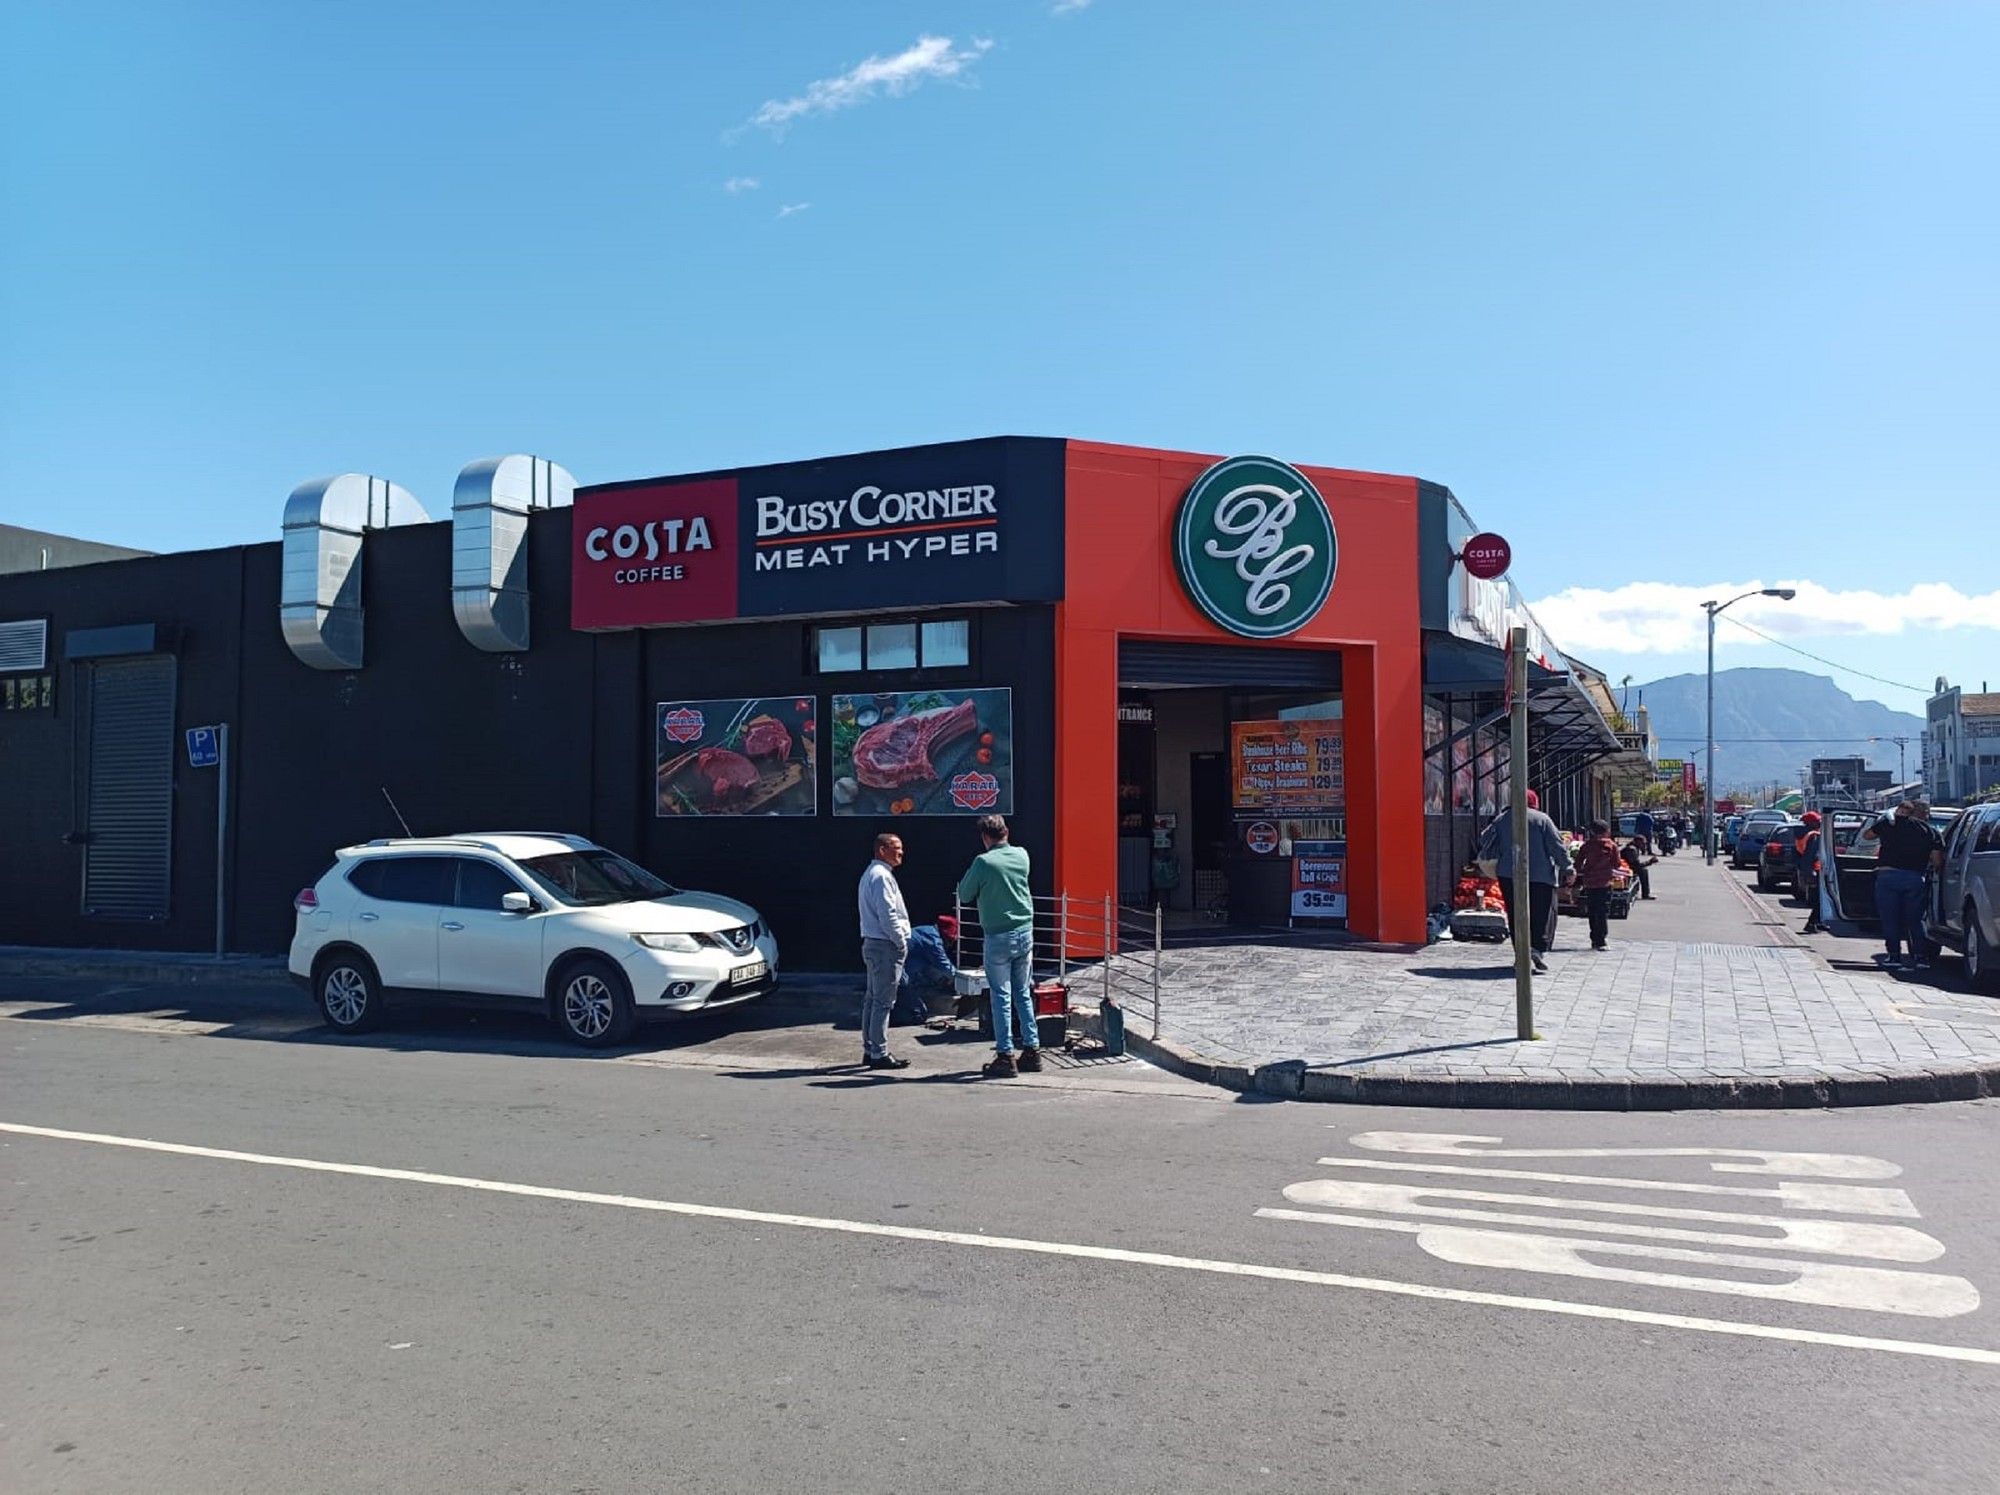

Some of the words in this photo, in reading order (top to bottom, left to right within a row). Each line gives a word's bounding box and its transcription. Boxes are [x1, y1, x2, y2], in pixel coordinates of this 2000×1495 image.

[585, 517, 712, 561] COSTA
[755, 545, 850, 571] MEAT
[868, 531, 998, 562] HYPER
[1469, 549, 1505, 558] COSTA
[615, 565, 684, 584] COFFEE
[195, 730, 208, 748] P
[1274, 759, 1308, 772] Steaks
